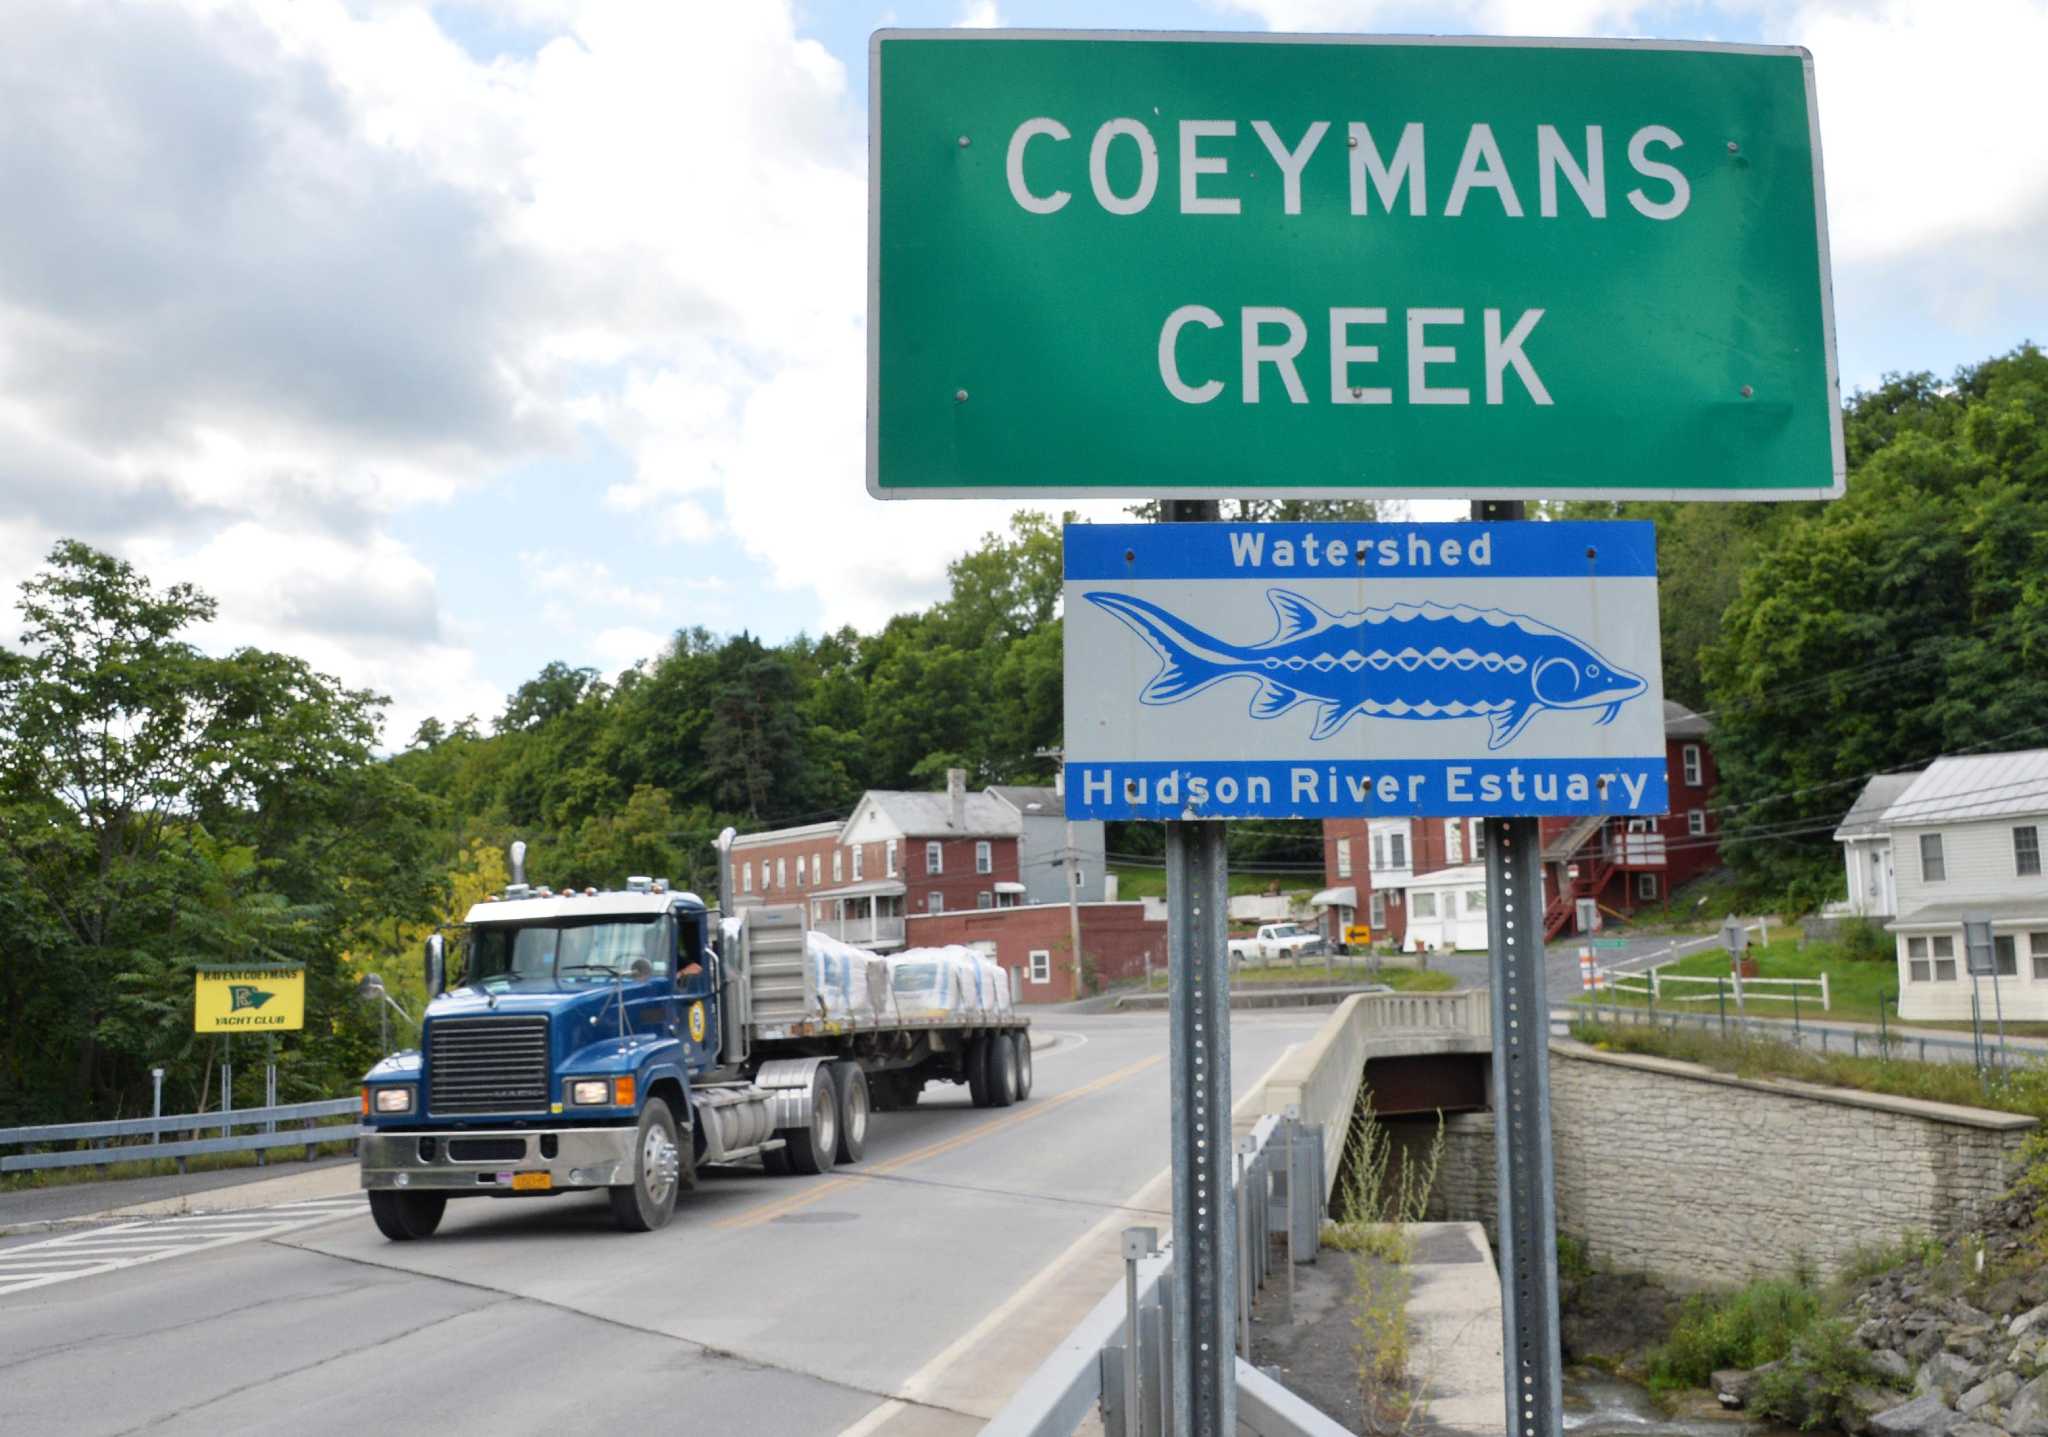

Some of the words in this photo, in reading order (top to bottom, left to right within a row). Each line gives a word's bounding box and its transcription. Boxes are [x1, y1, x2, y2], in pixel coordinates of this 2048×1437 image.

[1006, 117, 1690, 220] COEYMANS
[1158, 305, 1553, 405] CREEK
[1230, 532, 1491, 566] Watershed
[1084, 769, 1270, 804] Hudson
[1291, 768, 1425, 802] River
[1447, 767, 1647, 809] Estuary
[215, 1016, 252, 1025] YACHT
[254, 1015, 285, 1025] CLUB
